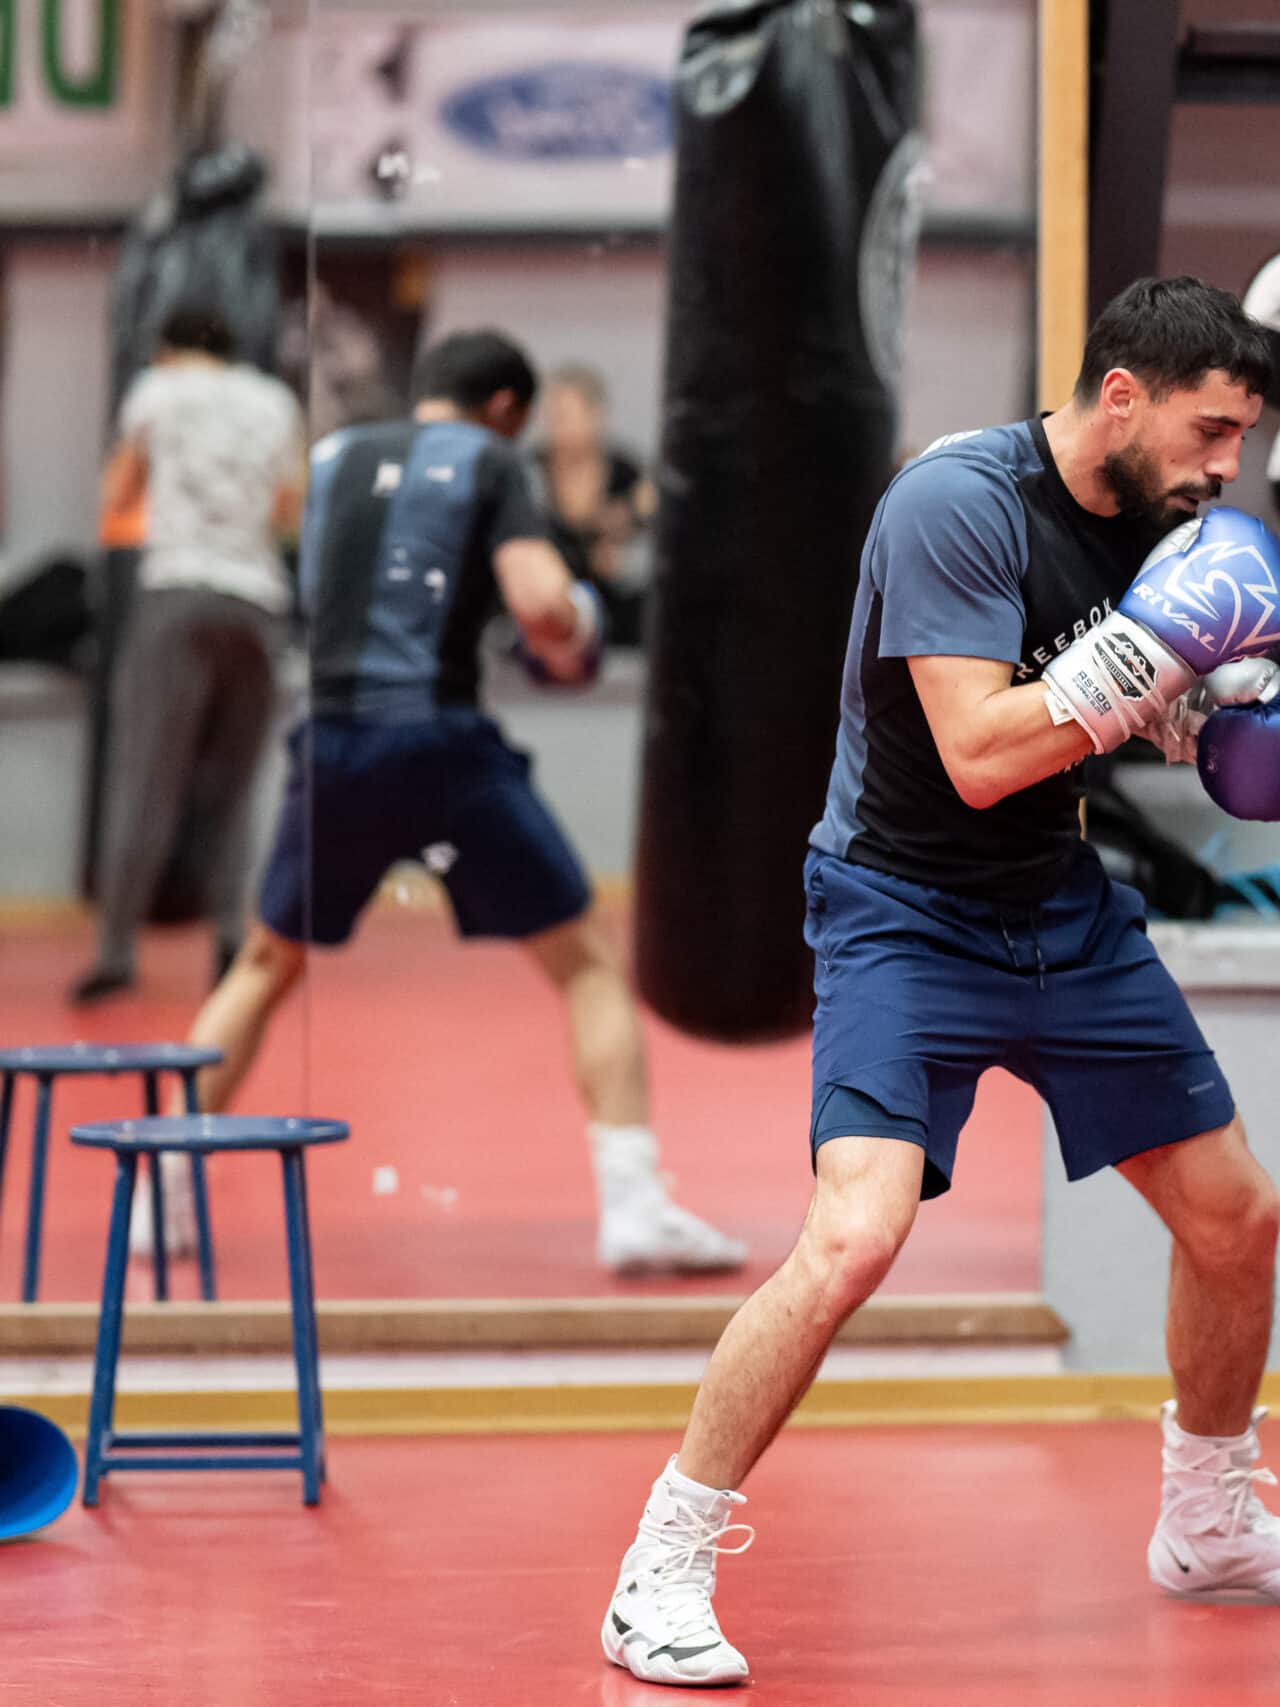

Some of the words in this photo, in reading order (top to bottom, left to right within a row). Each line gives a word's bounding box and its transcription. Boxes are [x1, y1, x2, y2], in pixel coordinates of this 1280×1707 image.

[1016, 597, 1113, 679] REEBOK
[1132, 582, 1217, 653] RIVAL
[1077, 669, 1113, 712] RS100
